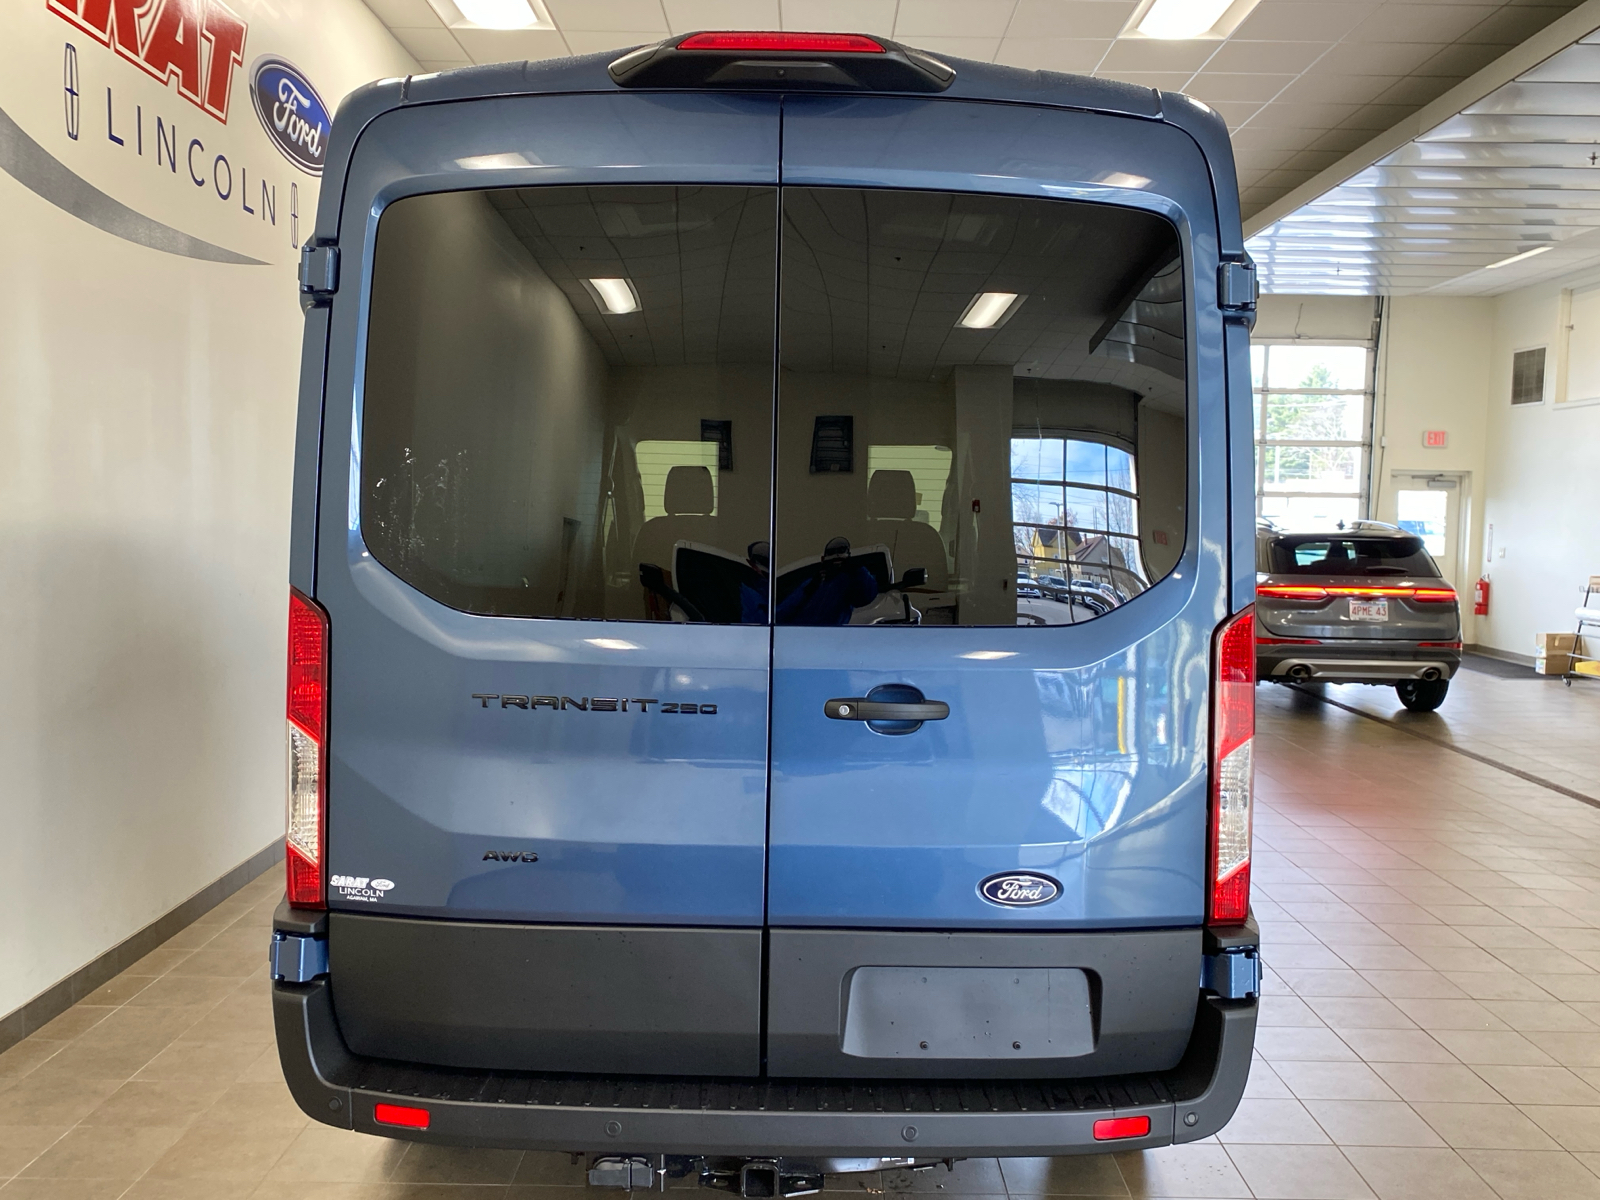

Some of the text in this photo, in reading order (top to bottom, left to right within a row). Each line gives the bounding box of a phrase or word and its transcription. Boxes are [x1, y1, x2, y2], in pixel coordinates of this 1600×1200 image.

[46, 0, 248, 125] RAT
[273, 77, 322, 158] Ford
[106, 86, 276, 227] LINCOLN
[1427, 430, 1446, 446] EXIT
[1351, 605, 1387, 617] 4PME 43
[472, 693, 718, 715] TRANSIT 250
[482, 850, 539, 863] AWD
[330, 874, 370, 888] SARAT
[997, 880, 1042, 900] Ford
[339, 886, 384, 897] LINCOLN
